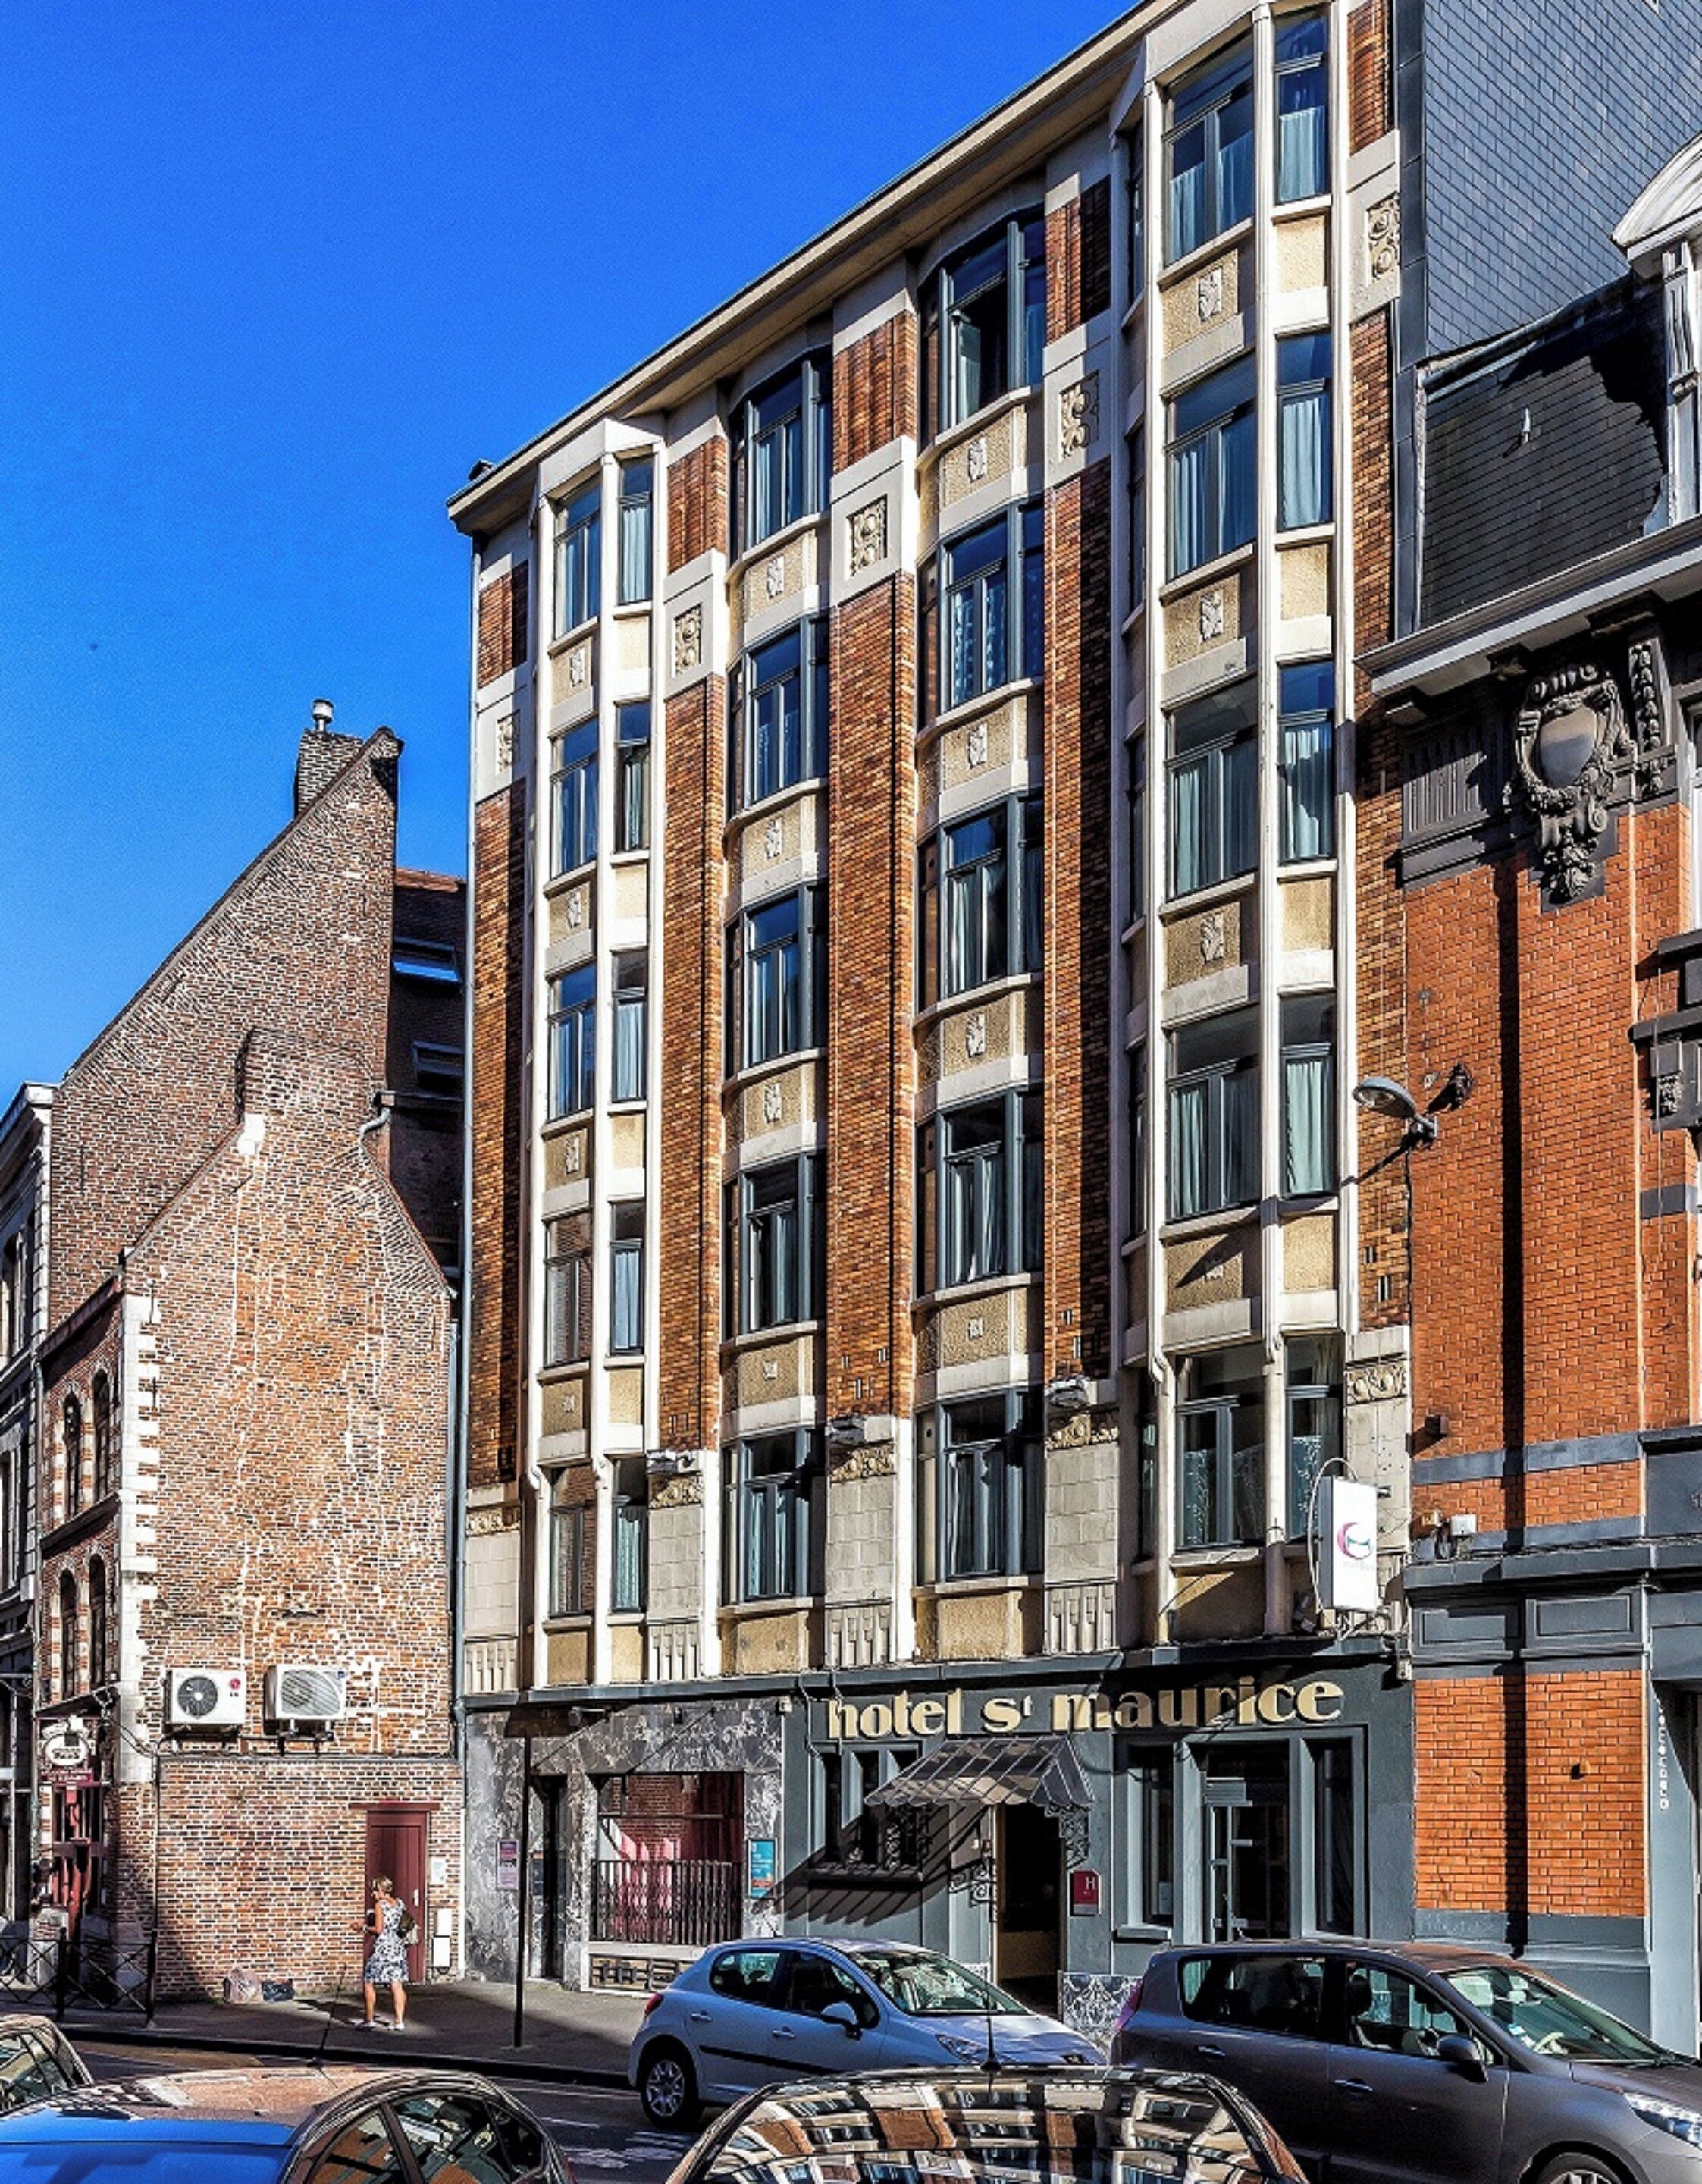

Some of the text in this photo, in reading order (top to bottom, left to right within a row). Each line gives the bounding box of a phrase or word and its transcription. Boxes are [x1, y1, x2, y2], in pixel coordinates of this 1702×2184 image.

[829, 1688, 961, 1739] hotel
[1052, 1674, 1344, 1729] maurice
[1086, 1876, 1095, 1890] H
